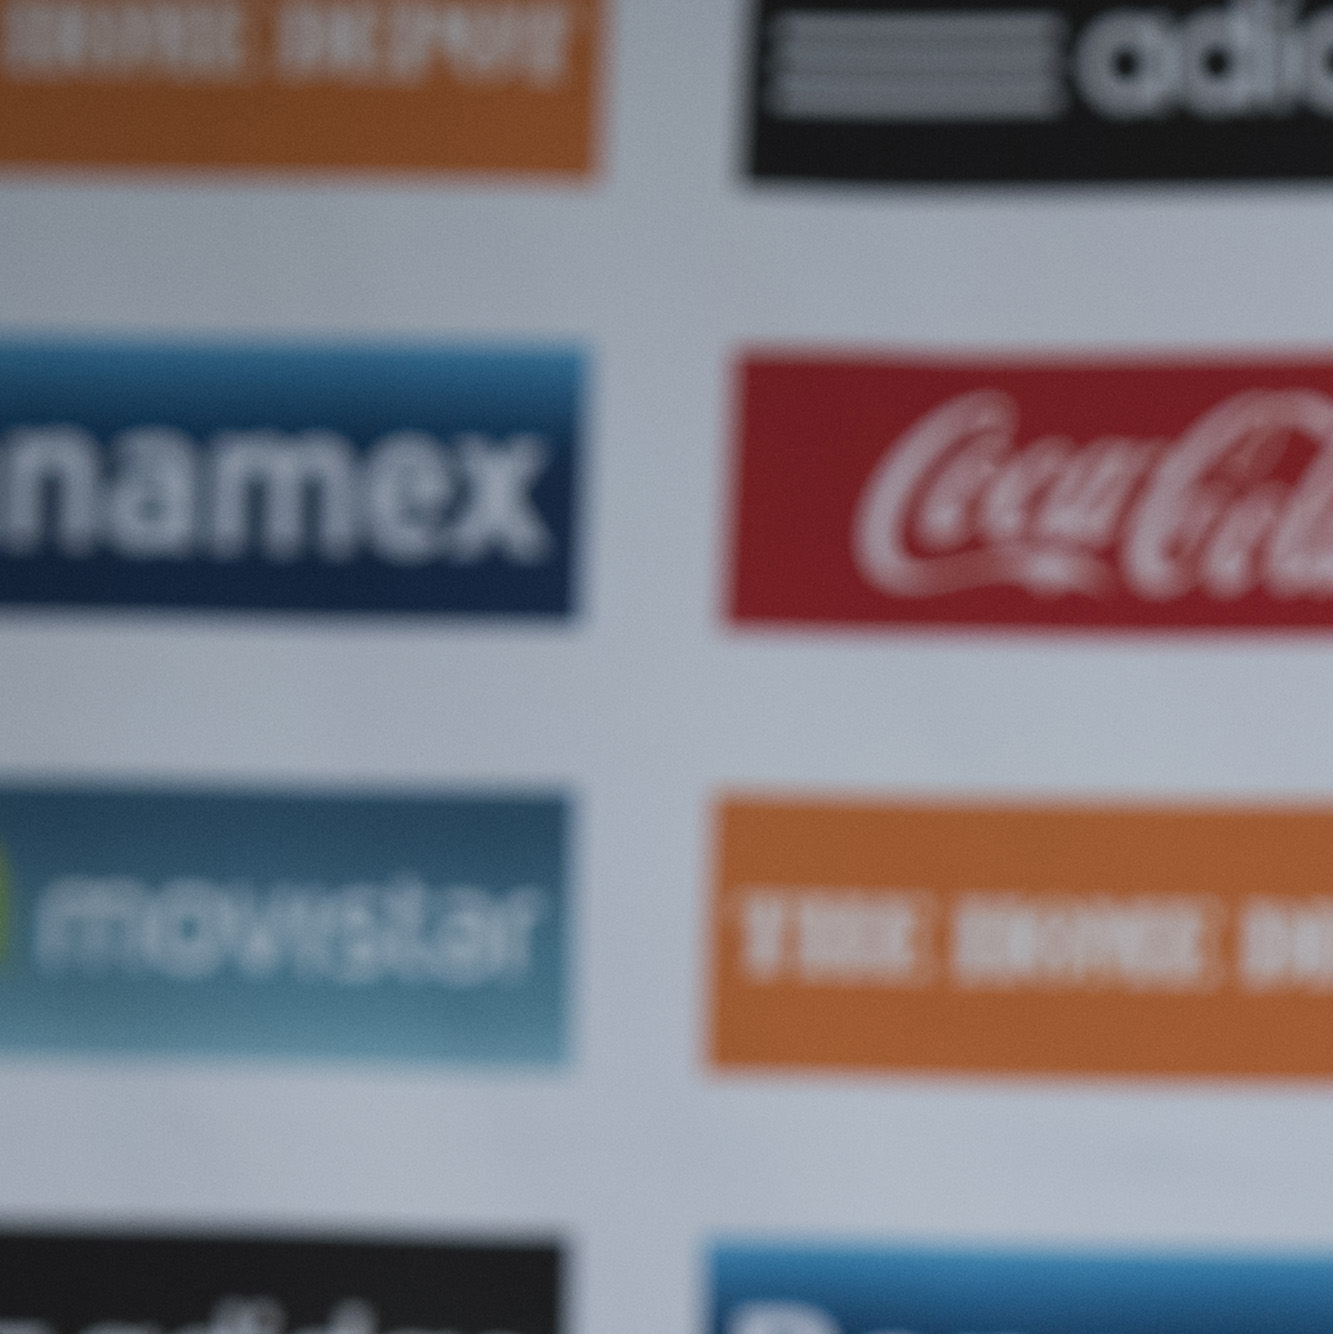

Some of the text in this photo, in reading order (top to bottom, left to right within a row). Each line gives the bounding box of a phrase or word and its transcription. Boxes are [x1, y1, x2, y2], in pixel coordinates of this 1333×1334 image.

[0, 422, 556, 566] namex
[27, 868, 546, 989] movistar
[728, 886, 938, 984] THE
[948, 889, 1228, 992] HOME
